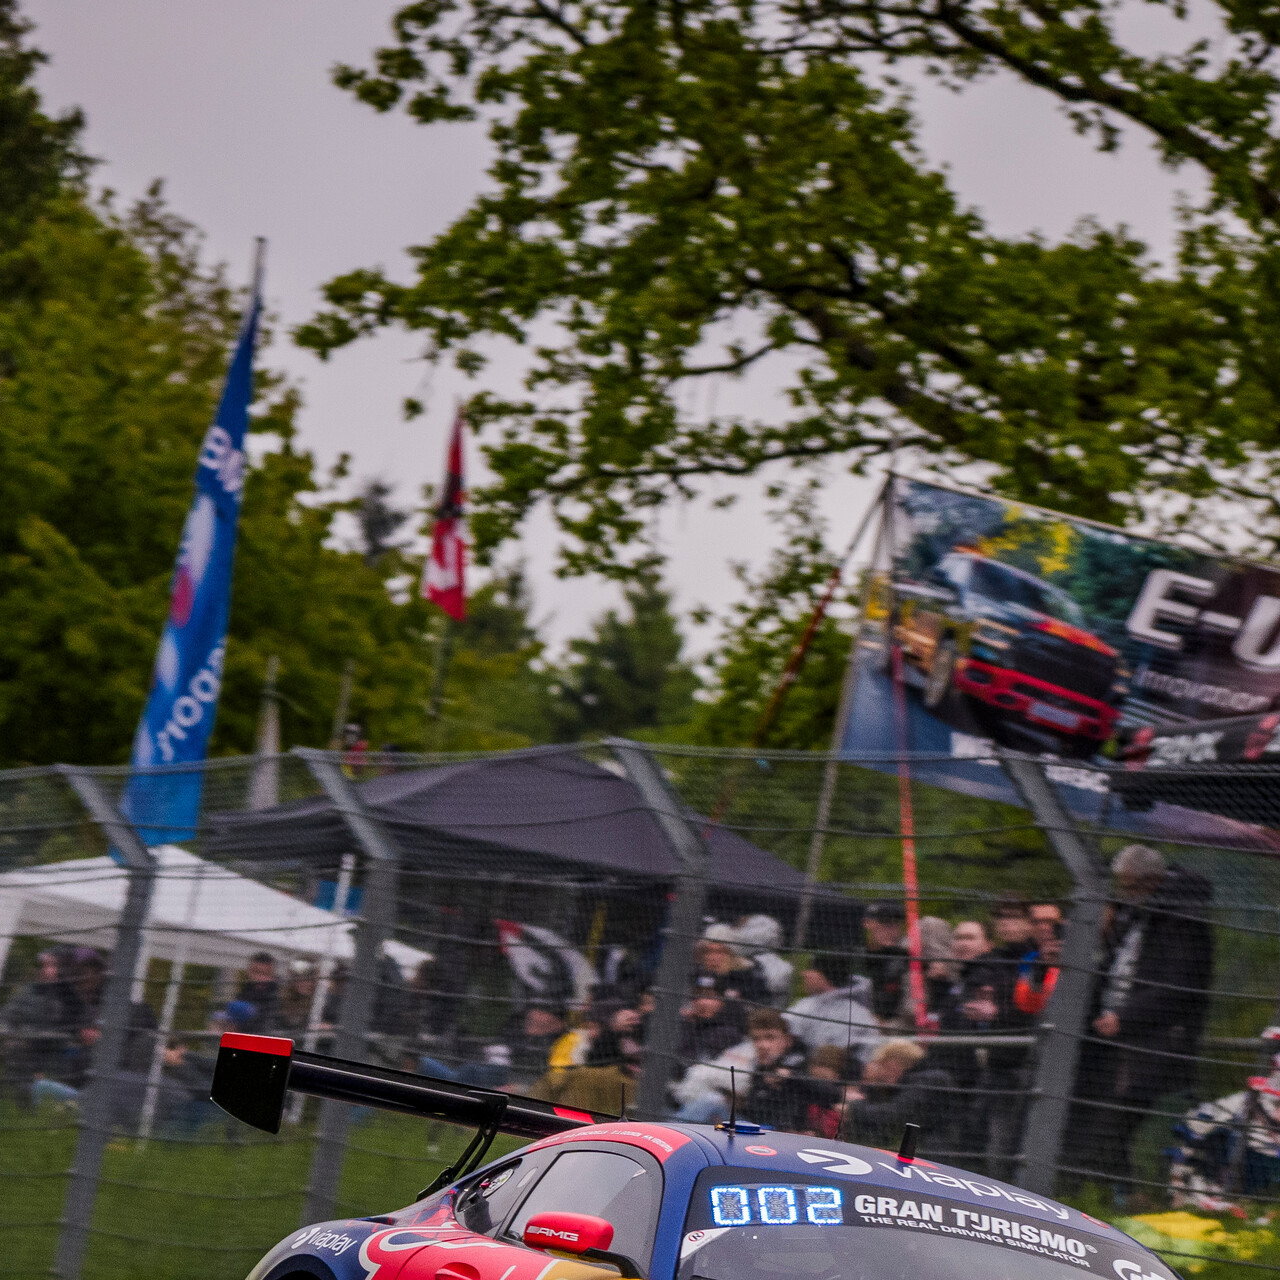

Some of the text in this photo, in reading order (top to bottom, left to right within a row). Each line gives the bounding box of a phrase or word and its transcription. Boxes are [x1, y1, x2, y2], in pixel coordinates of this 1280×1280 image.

[710, 1186, 843, 1226] 002
[854, 1194, 944, 1224] GRAN
[877, 1161, 1070, 1221] viaplay
[310, 1228, 357, 1256] viaplay
[861, 1215, 1091, 1269] THE REAL DRIVING SIMULATOR
